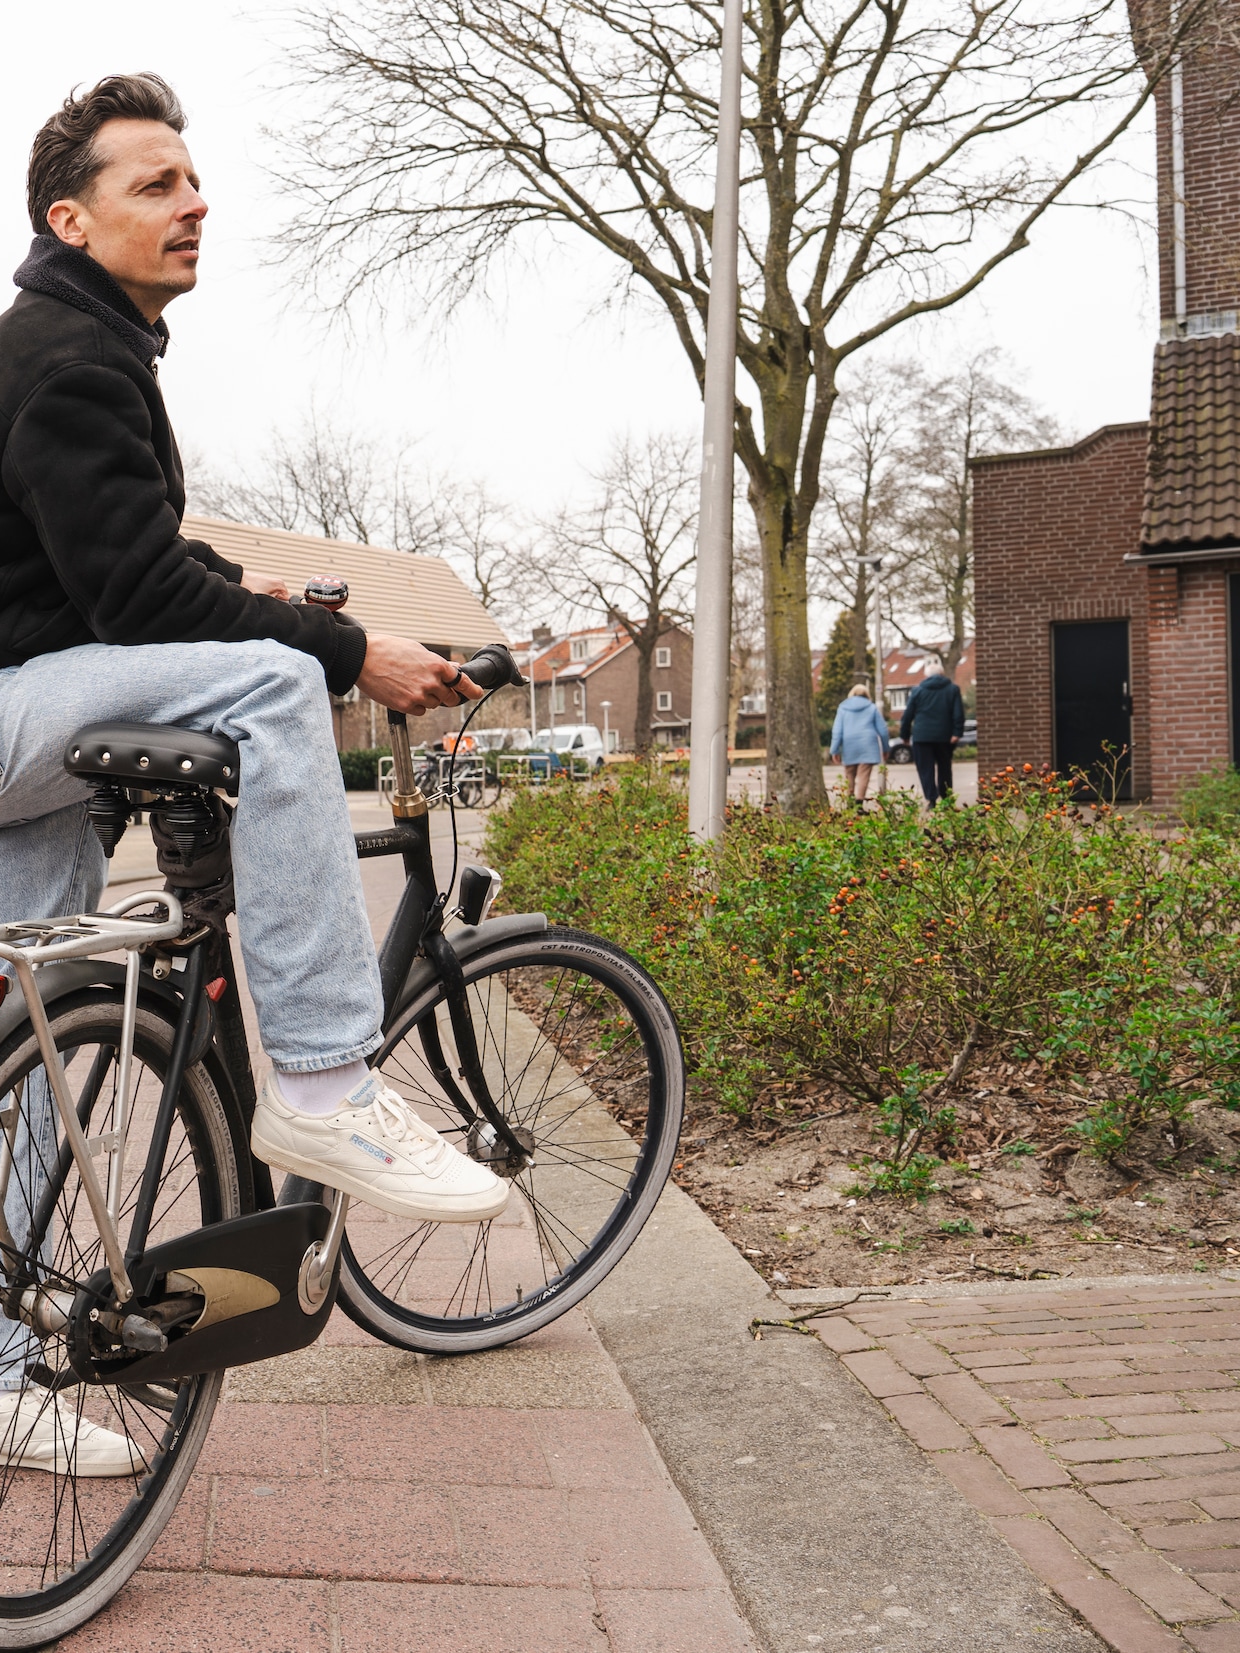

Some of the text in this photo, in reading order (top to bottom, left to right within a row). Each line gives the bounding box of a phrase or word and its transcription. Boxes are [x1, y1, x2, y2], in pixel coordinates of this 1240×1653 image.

[560, 944, 624, 971] METROPOLITAN
[623, 968, 655, 1000] PALMBAY
[350, 1079, 375, 1103] Reebok
[198, 1069, 241, 1216] METROPOLITAN PALMBA
[351, 1133, 387, 1161] Reebok
